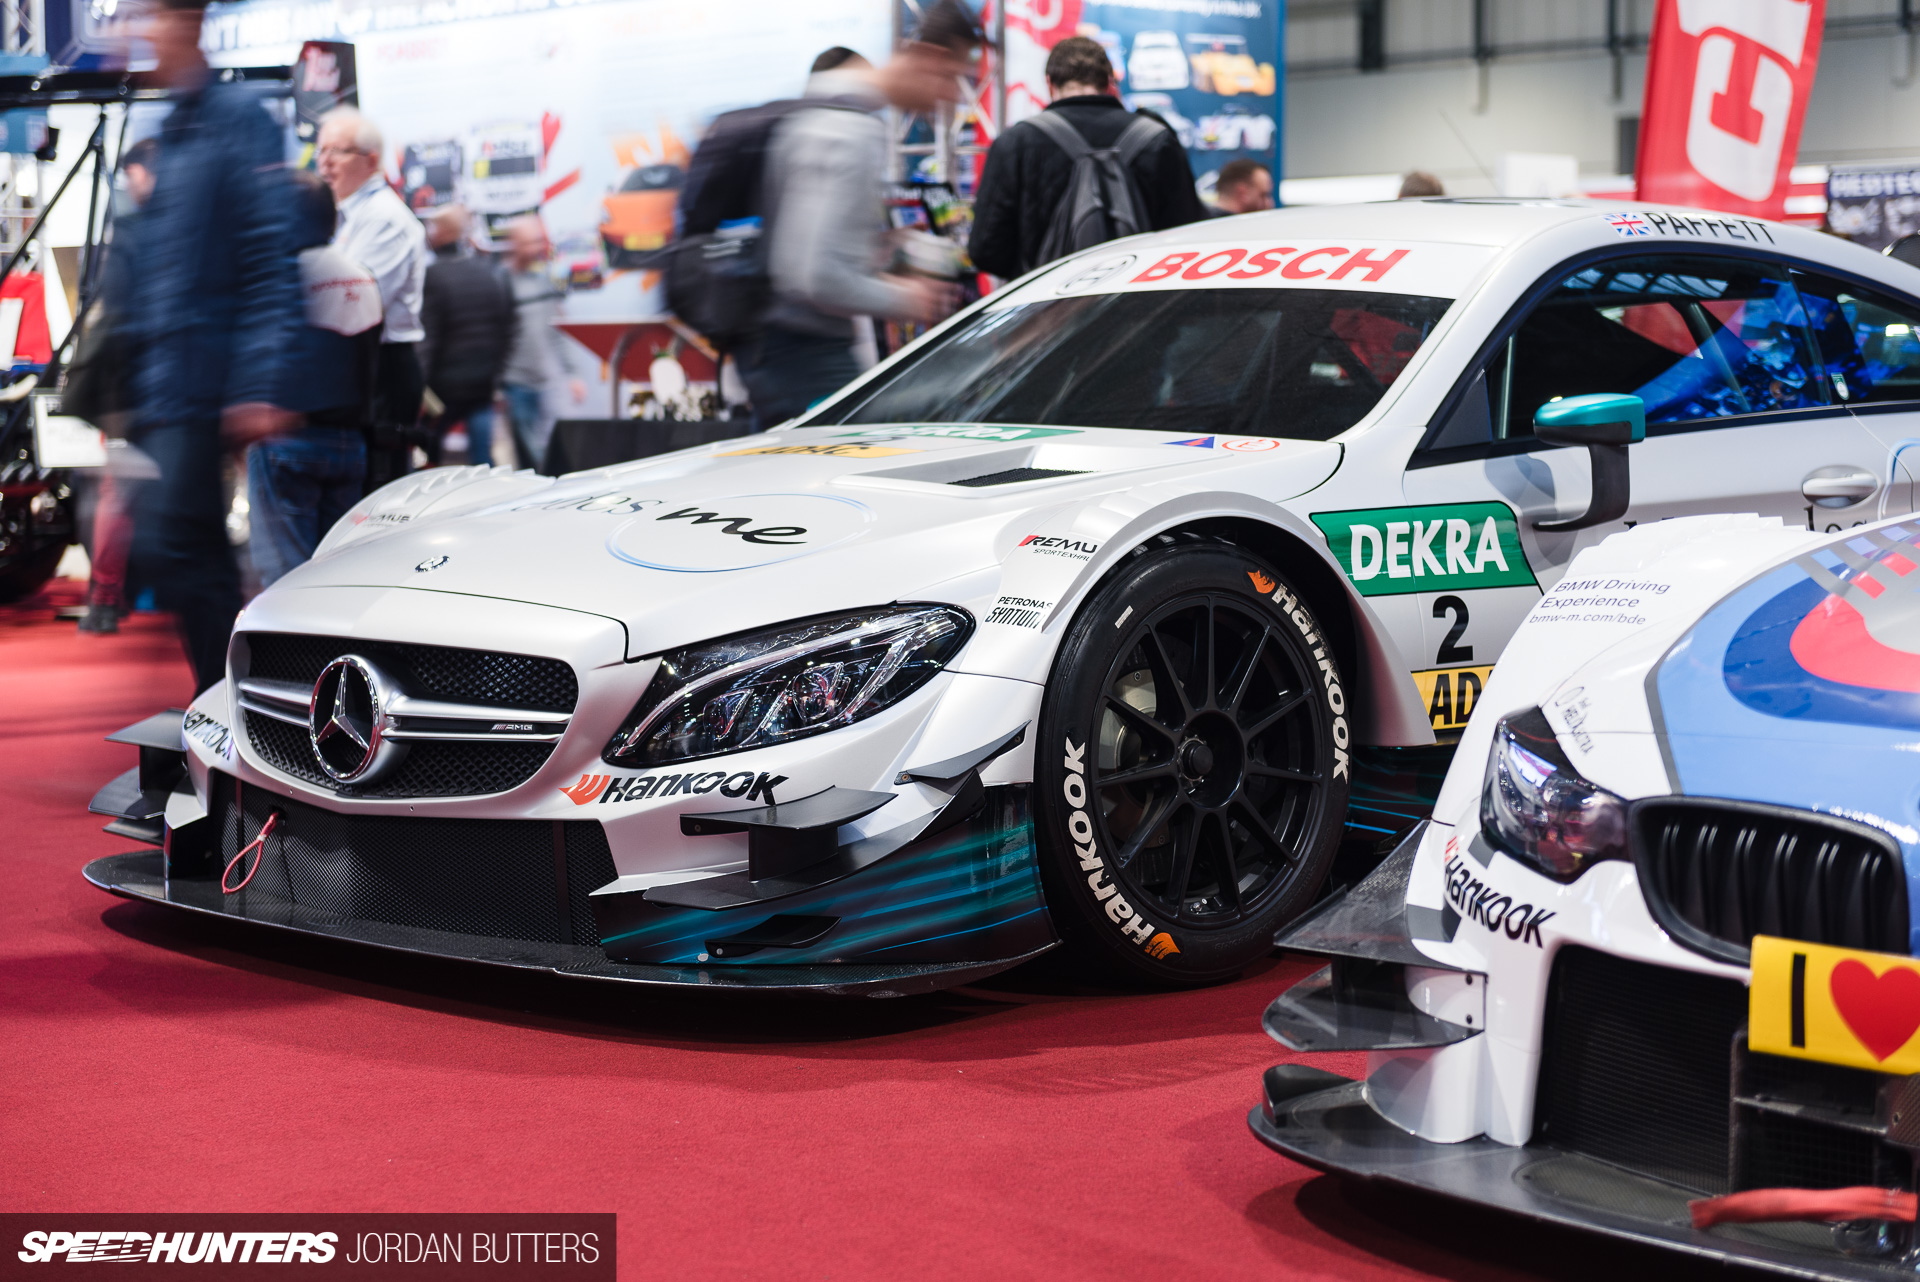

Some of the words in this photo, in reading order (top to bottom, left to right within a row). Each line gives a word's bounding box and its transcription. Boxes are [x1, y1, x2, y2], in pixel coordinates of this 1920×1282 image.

[1644, 212, 1776, 246] PAFFETT
[1127, 245, 1411, 284] BOSCH
[656, 507, 808, 545] me
[1025, 536, 1098, 554] REMU
[1349, 515, 1510, 581] DEKRA
[997, 596, 1053, 609] PETRONAS
[1541, 596, 1640, 609] Experience
[1554, 580, 1605, 593] BMW
[1605, 579, 1671, 595] Driving
[1432, 594, 1474, 665] 2
[1529, 614, 1646, 626] bmw-m.com/bde
[1431, 670, 1494, 726] AD
[1789, 952, 1807, 1048] I
